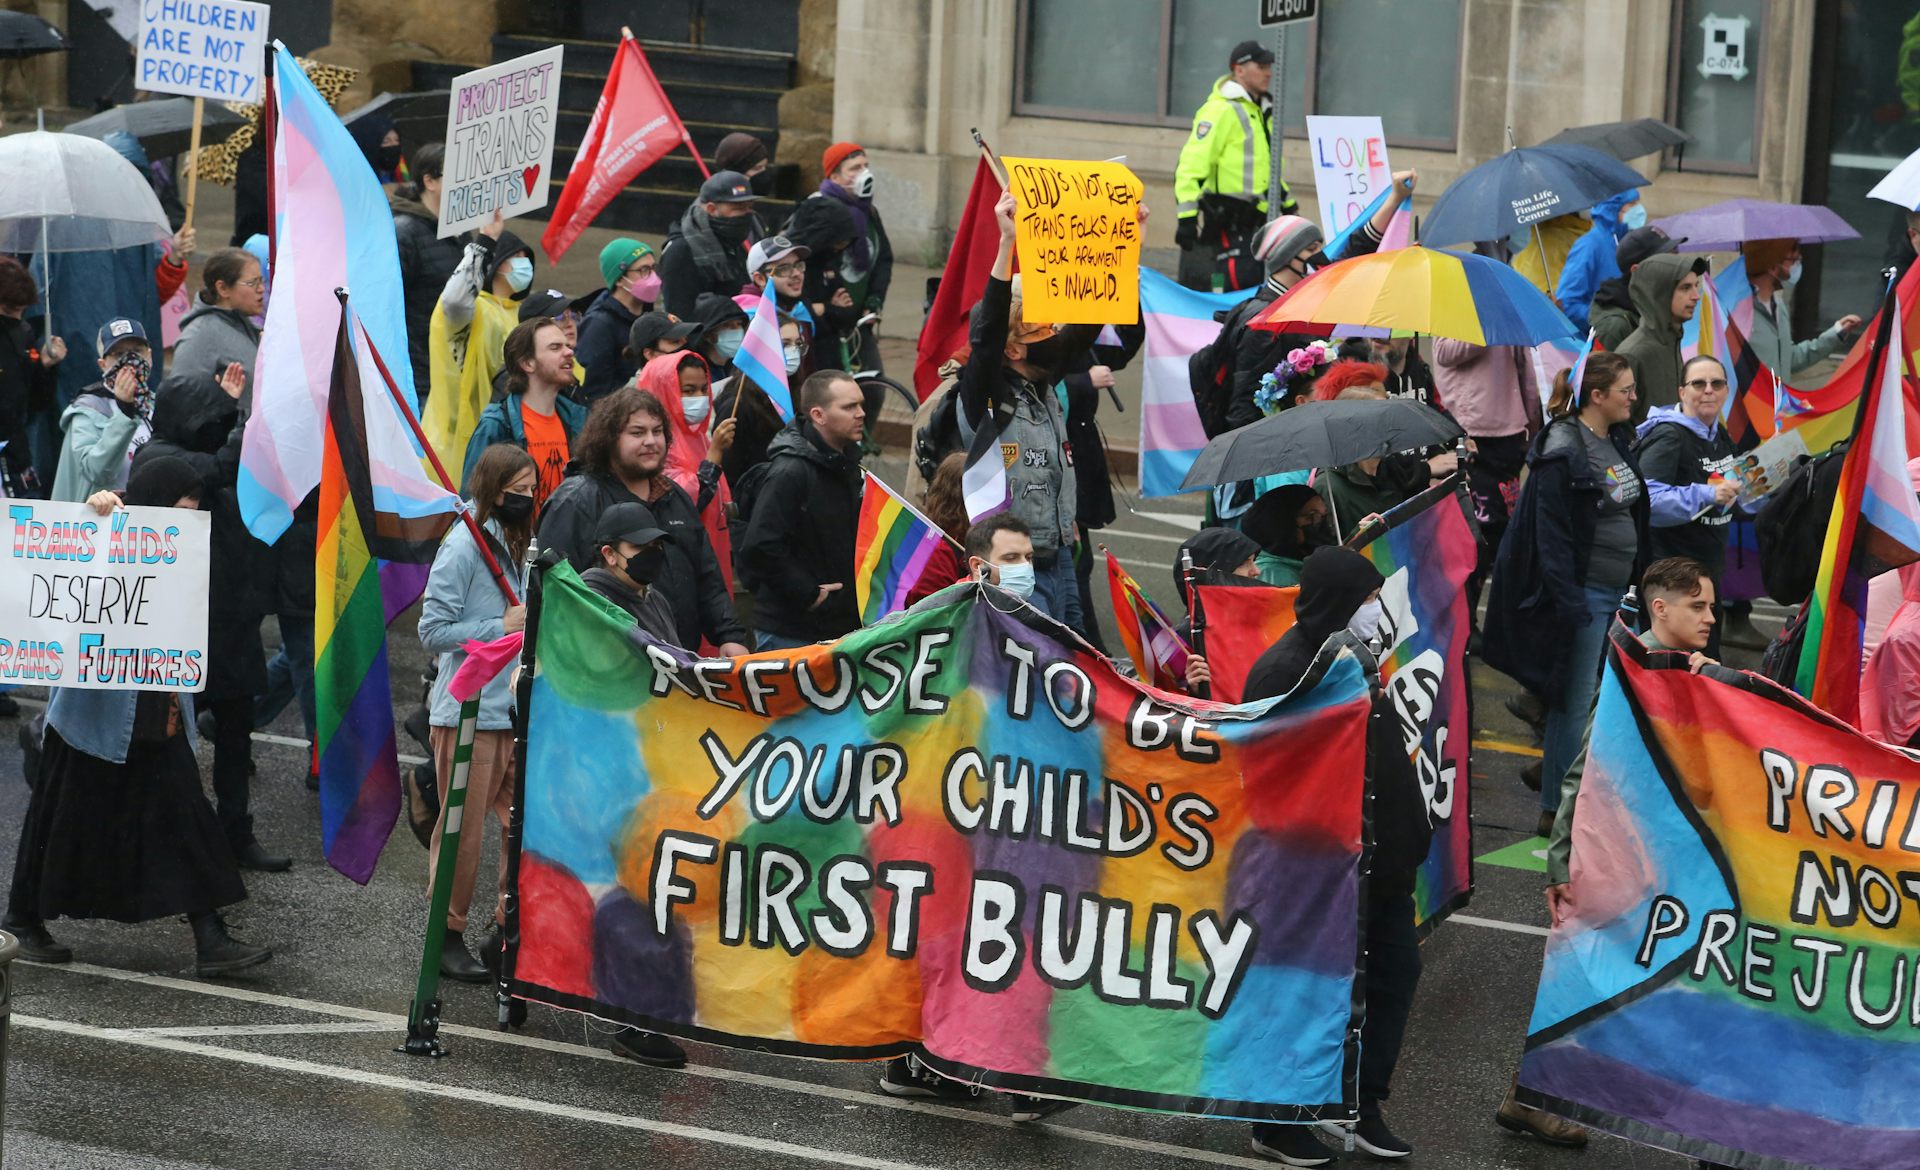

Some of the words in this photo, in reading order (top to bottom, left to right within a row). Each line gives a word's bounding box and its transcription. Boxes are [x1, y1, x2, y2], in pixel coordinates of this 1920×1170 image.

[144, 0, 256, 32] CHILDREN
[144, 27, 192, 55] ARE
[204, 35, 245, 63] NOT
[1706, 57, 1740, 69] C-074
[143, 58, 255, 97] PROPERTY
[456, 62, 554, 125] PROTECT
[454, 106, 548, 184] TRANS
[1318, 137, 1384, 170] LOVE
[446, 169, 523, 225] RIGHTS
[1071, 172, 1104, 200] NOT
[1344, 173, 1368, 195] IS
[1511, 197, 1532, 209] Sun
[1533, 189, 1553, 202] Life
[1330, 201, 1366, 238] LO
[1514, 194, 1560, 217] Financial
[1517, 208, 1551, 224] Centre
[1023, 212, 1065, 240] TRANS
[1070, 214, 1108, 241] FOLKS
[1075, 245, 1127, 268] ARGUMENT
[1046, 277, 1059, 299] IS
[9, 505, 98, 562] TRANS
[108, 512, 180, 564] KIDS
[29, 574, 157, 625] DESERVE
[0, 638, 64, 680] RANS
[78, 633, 202, 687] FUTURES
[646, 628, 957, 718] REFUSE
[1004, 637, 1096, 733] TO
[1125, 695, 1221, 764] BE
[696, 728, 908, 828] YOUR
[941, 746, 1219, 871] CHILD'S
[1759, 747, 1920, 851] PRI
[652, 828, 935, 960] FIRST
[961, 869, 1258, 1021] BULLY
[1635, 895, 1920, 1031] PREJU
